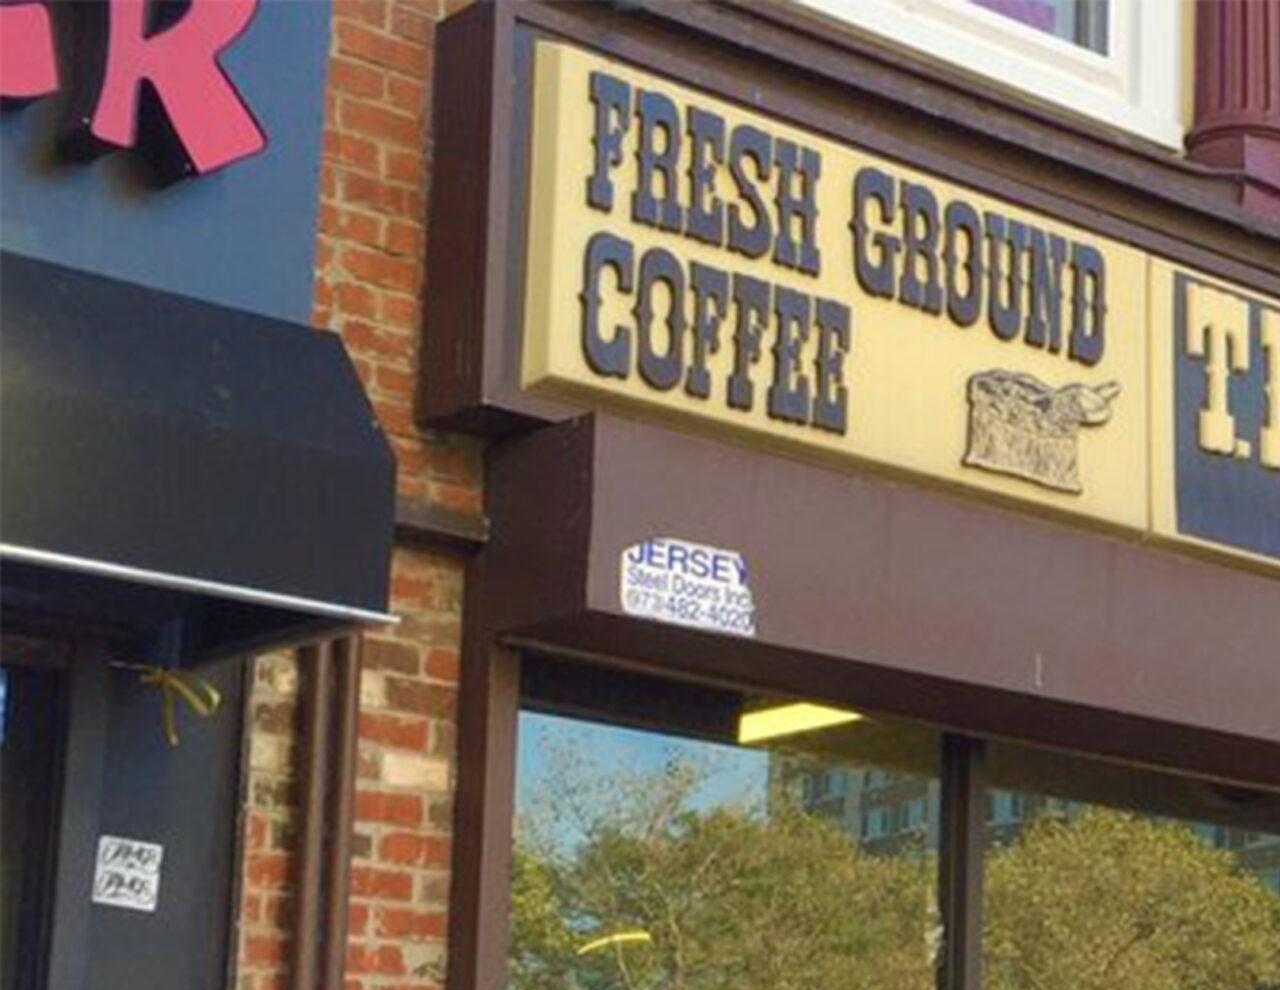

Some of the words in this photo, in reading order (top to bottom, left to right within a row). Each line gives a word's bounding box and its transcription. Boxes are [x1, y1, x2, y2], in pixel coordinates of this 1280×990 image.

[0, 0, 267, 175] R
[586, 70, 822, 277] FRESH
[850, 166, 1107, 367] GROUND
[580, 231, 851, 436] COFFEE
[628, 543, 750, 585] JERSEY
[672, 575, 721, 601] Doors
